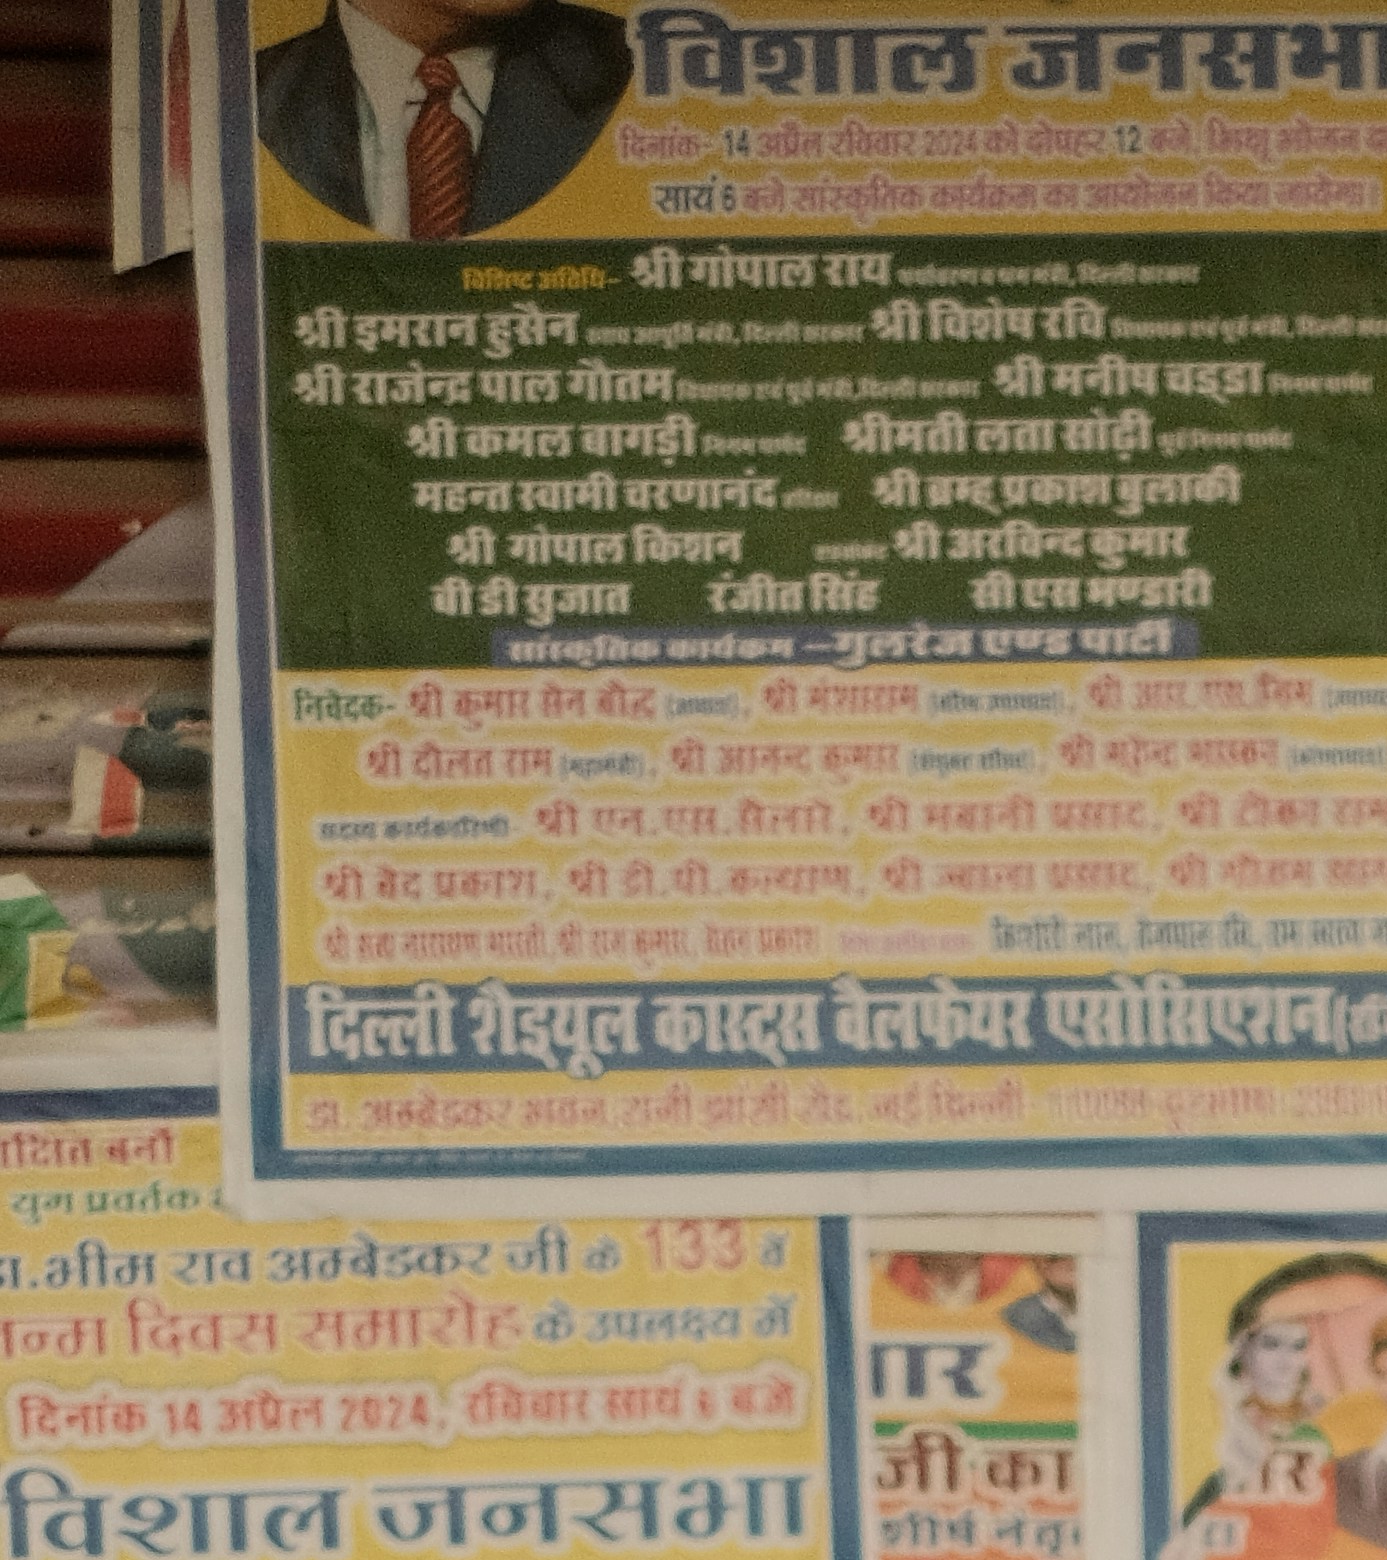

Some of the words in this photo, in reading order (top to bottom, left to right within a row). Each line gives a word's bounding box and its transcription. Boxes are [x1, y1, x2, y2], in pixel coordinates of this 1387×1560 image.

[634, 8, 986, 97] विशाल
[724, 126, 749, 156] 14
[1114, 123, 1143, 154] 12
[294, 306, 346, 349] श्री
[354, 313, 479, 349] इमरान
[483, 304, 579, 358] हुसैन
[870, 297, 919, 343] श्री
[928, 297, 1036, 343] विशेष
[1042, 297, 1108, 341] रवि
[295, 360, 344, 405] श्री
[352, 361, 470, 405] राजेन्द्र
[477, 367, 559, 402] पाल
[566, 359, 675, 400] गौतम
[406, 415, 457, 459] श्री
[463, 424, 571, 458] कमल
[413, 479, 510, 512] महन्त
[517, 471, 618, 512] स्वामी
[447, 525, 496, 567] श्री
[507, 525, 625, 564] गोपाल
[632, 523, 744, 563] किशन
[895, 521, 941, 561] श्री
[947, 519, 1086, 559] अरविन्द
[1092, 525, 1189, 568] कुमार
[706, 571, 802, 614] रंजीत
[809, 568, 882, 613] सिंह
[970, 569, 1015, 611] सी
[1022, 576, 1079, 611] एस
[293, 687, 395, 722] निवेदक-
[409, 680, 443, 718] श्री
[454, 687, 530, 731] कुमार
[307, 982, 458, 1059] दिल्ली
[830, 972, 1036, 1053] वैलफेयर
[11, 1190, 74, 1225] युग
[169, 1249, 252, 1285] राव
[269, 1232, 491, 1286] अम्बेडकर
[505, 1221, 570, 1276] जी
[644, 1223, 743, 1271] 133
[127, 1295, 281, 1357] दिवस
[300, 1292, 523, 1349] समारोह
[532, 1299, 572, 1345] के
[752, 1293, 796, 1338] में
[19, 1392, 147, 1440] दिनांक
[162, 1398, 201, 1434] 14
[217, 1385, 324, 1437] अप्रैल
[467, 1384, 591, 1430] रविवार
[604, 1380, 688, 1424] सायं
[732, 1373, 797, 1419] बजे
[877, 1430, 964, 1494] जी
[986, 1445, 1076, 1492] का
[4, 1466, 350, 1559] विशाल
[374, 1474, 812, 1547] जनसभा
